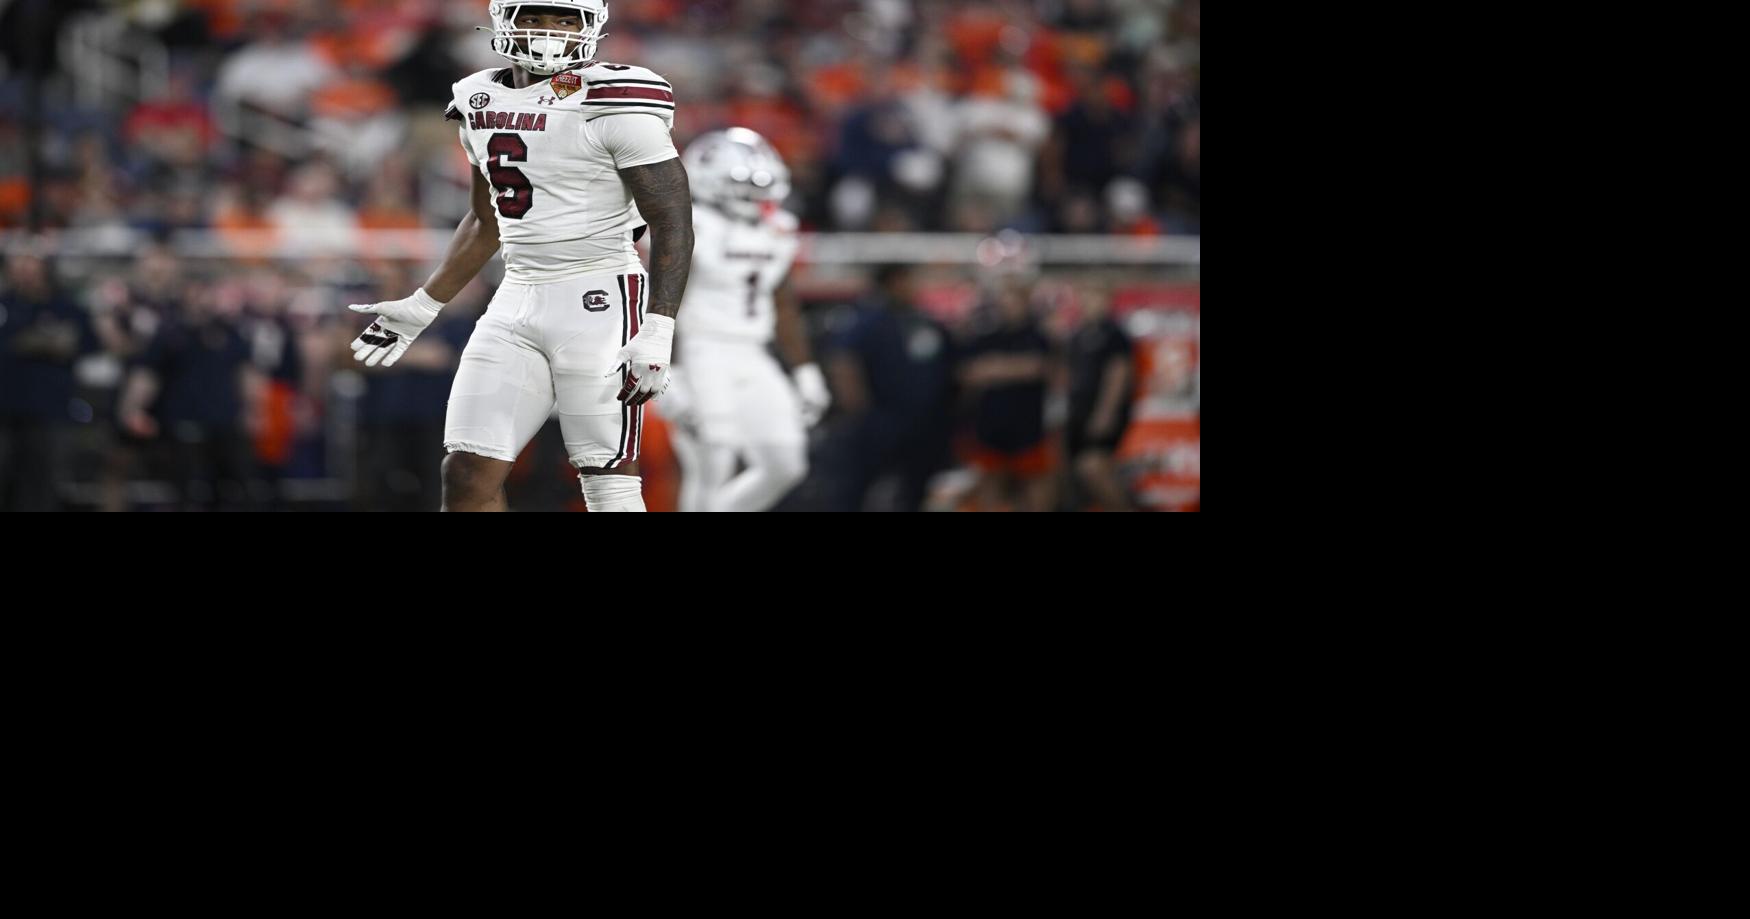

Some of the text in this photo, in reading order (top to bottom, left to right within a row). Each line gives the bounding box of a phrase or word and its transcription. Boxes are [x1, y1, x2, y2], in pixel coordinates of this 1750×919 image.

[470, 93, 489, 109] SEC
[468, 111, 547, 131] CAROLINA
[487, 132, 533, 220] 6
